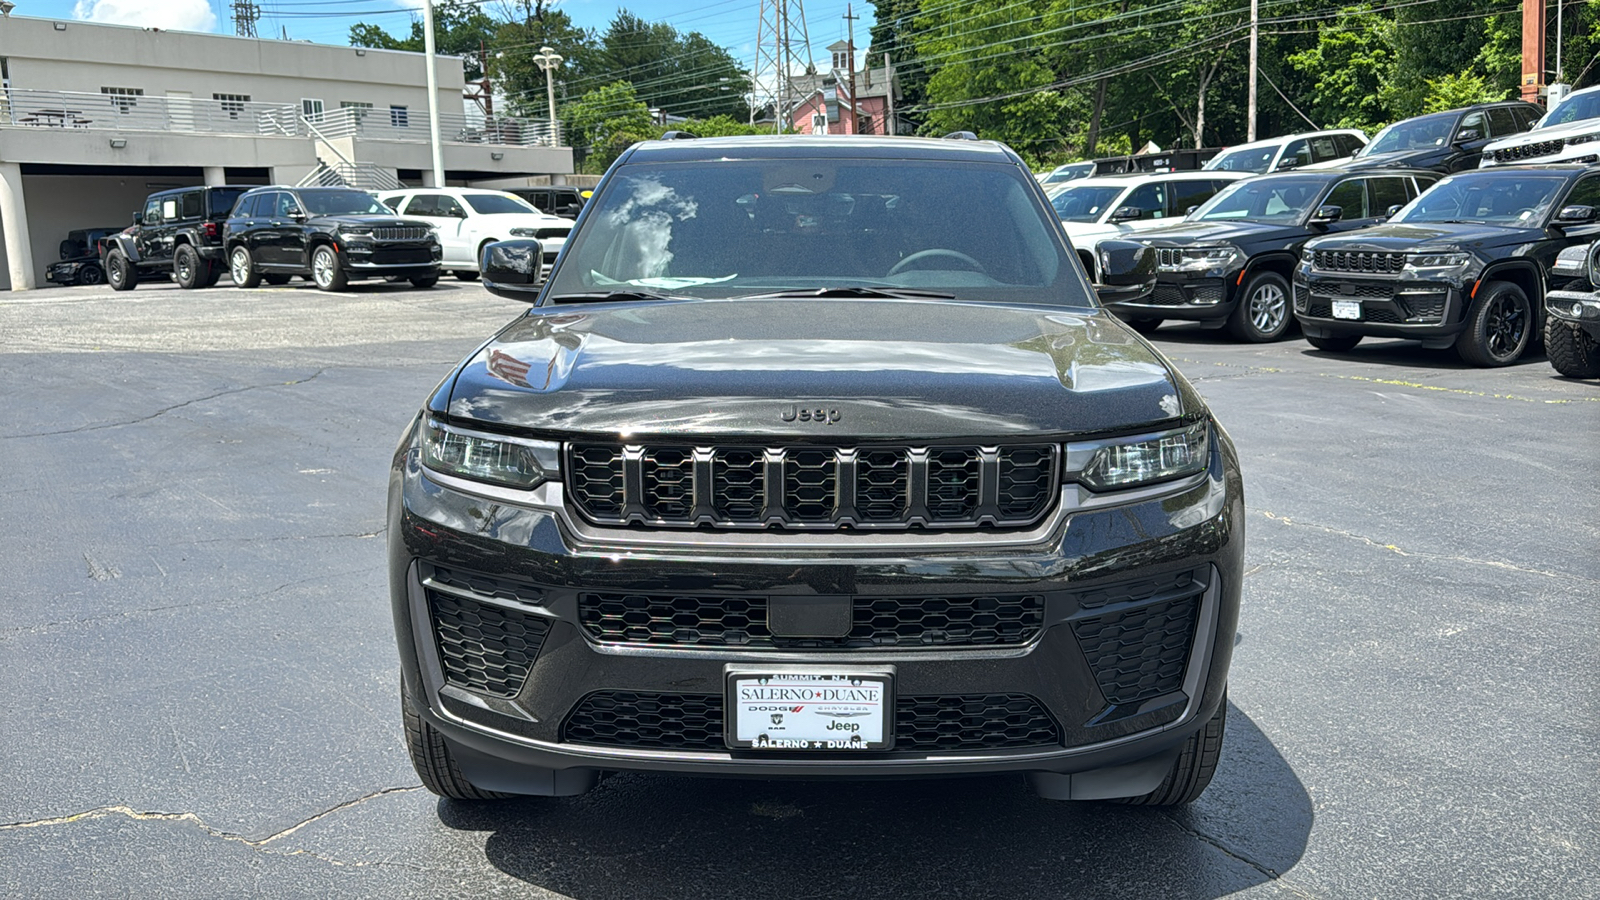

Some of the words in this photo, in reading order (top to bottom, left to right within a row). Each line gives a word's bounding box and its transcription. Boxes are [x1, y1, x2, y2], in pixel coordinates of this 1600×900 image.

[780, 405, 842, 426] Jeep
[741, 688, 814, 701] SALERNO
[823, 689, 879, 702] DUANE
[826, 720, 860, 733] Jeep
[751, 738, 809, 749] SALERNO
[827, 740, 868, 749] DUANE
